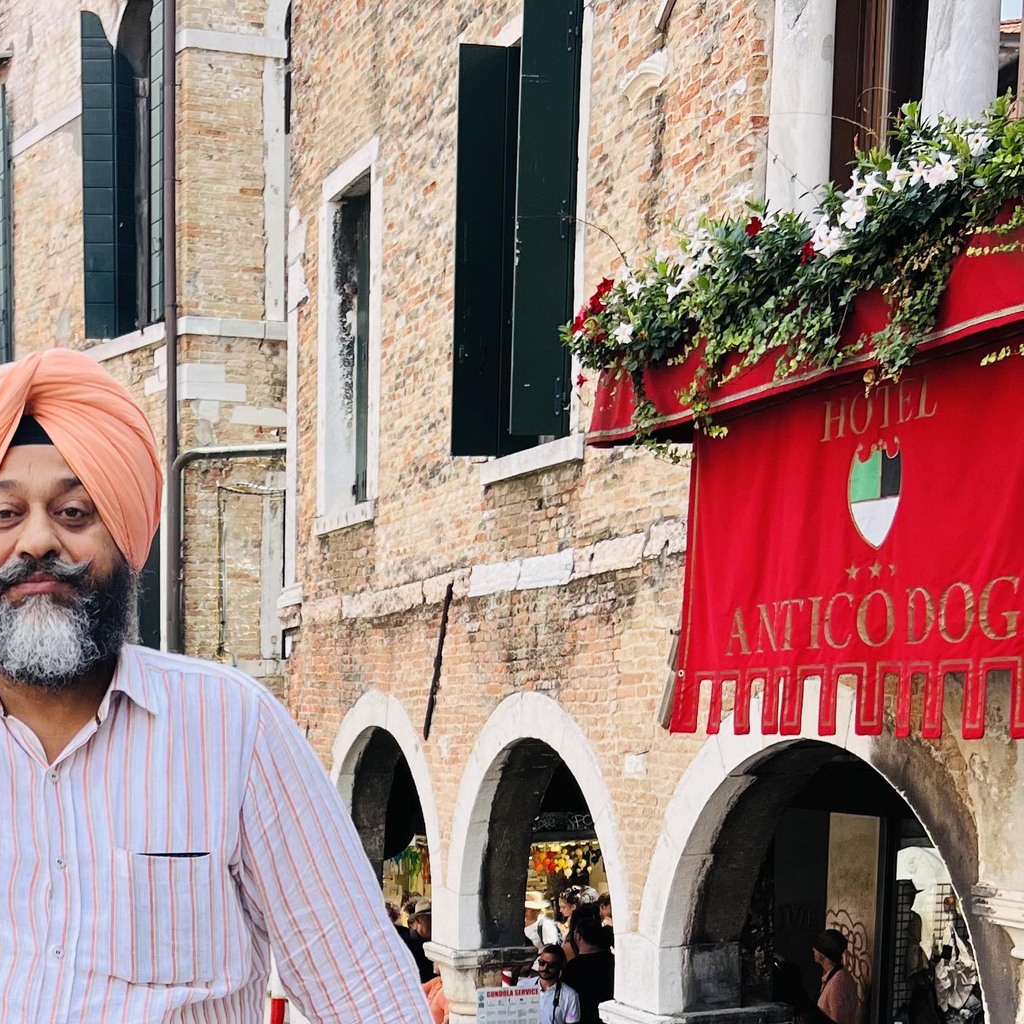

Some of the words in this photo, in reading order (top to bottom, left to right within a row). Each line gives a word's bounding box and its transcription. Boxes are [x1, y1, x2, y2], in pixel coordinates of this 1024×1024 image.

[820, 376, 938, 443] HOTEL
[725, 588, 896, 657] ANTICO
[905, 575, 1022, 646] DOG
[486, 990, 514, 998] GONDOLA
